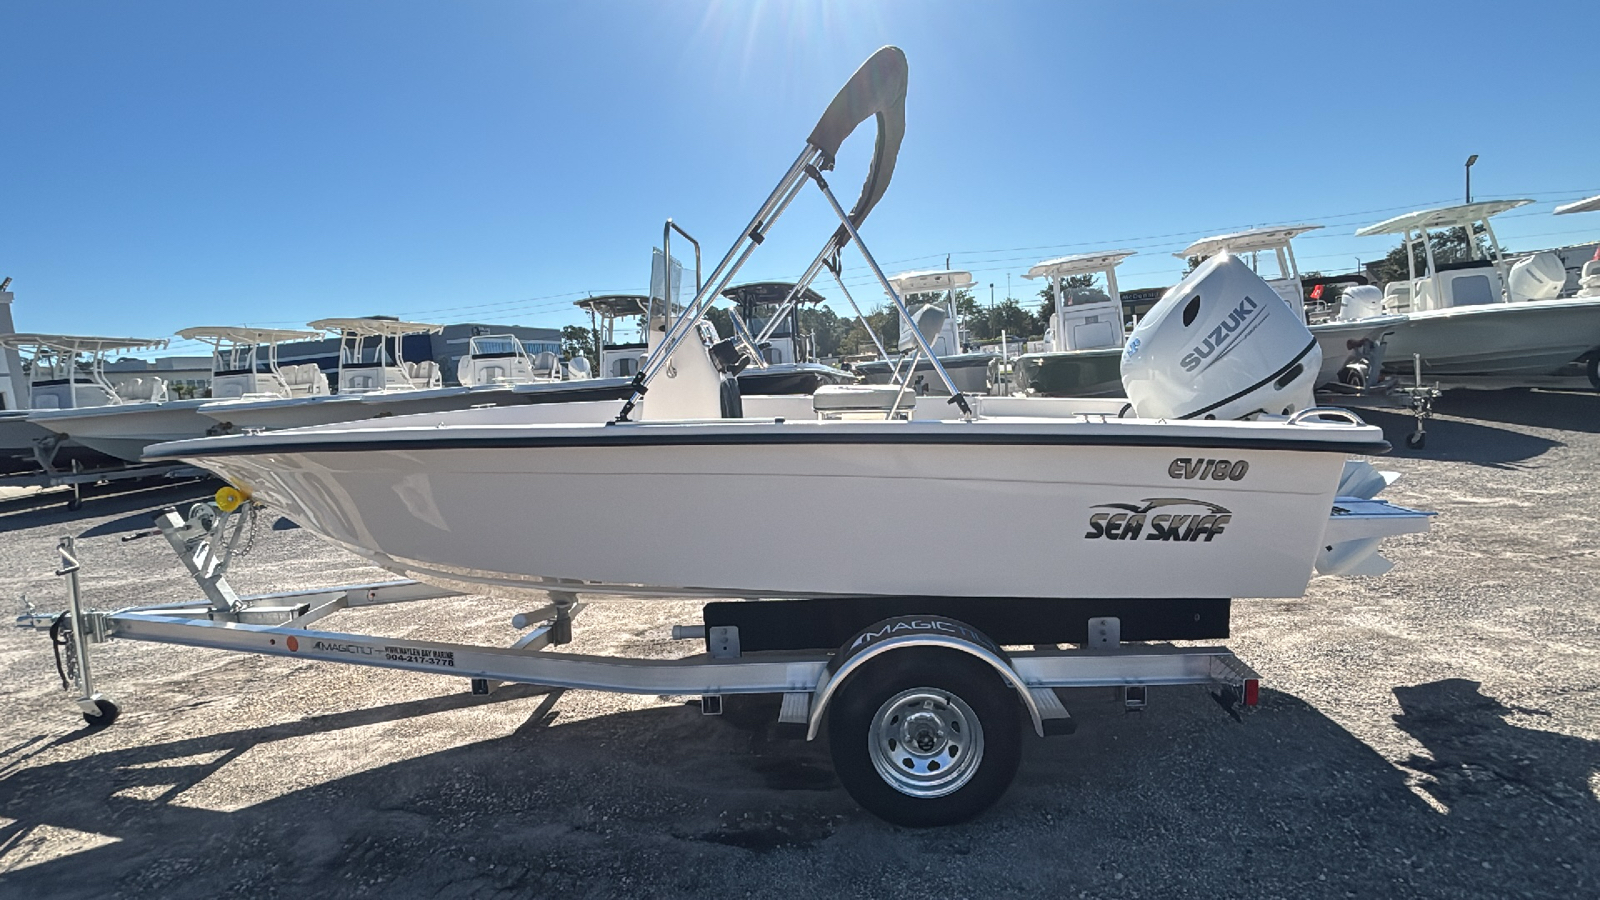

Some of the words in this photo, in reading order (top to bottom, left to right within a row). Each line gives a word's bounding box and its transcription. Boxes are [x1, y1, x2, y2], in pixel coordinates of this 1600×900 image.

[1179, 296, 1258, 373] SUZUKI
[1168, 458, 1249, 481] EV180
[1084, 512, 1147, 541] SEA
[1145, 514, 1232, 542] SKIFF
